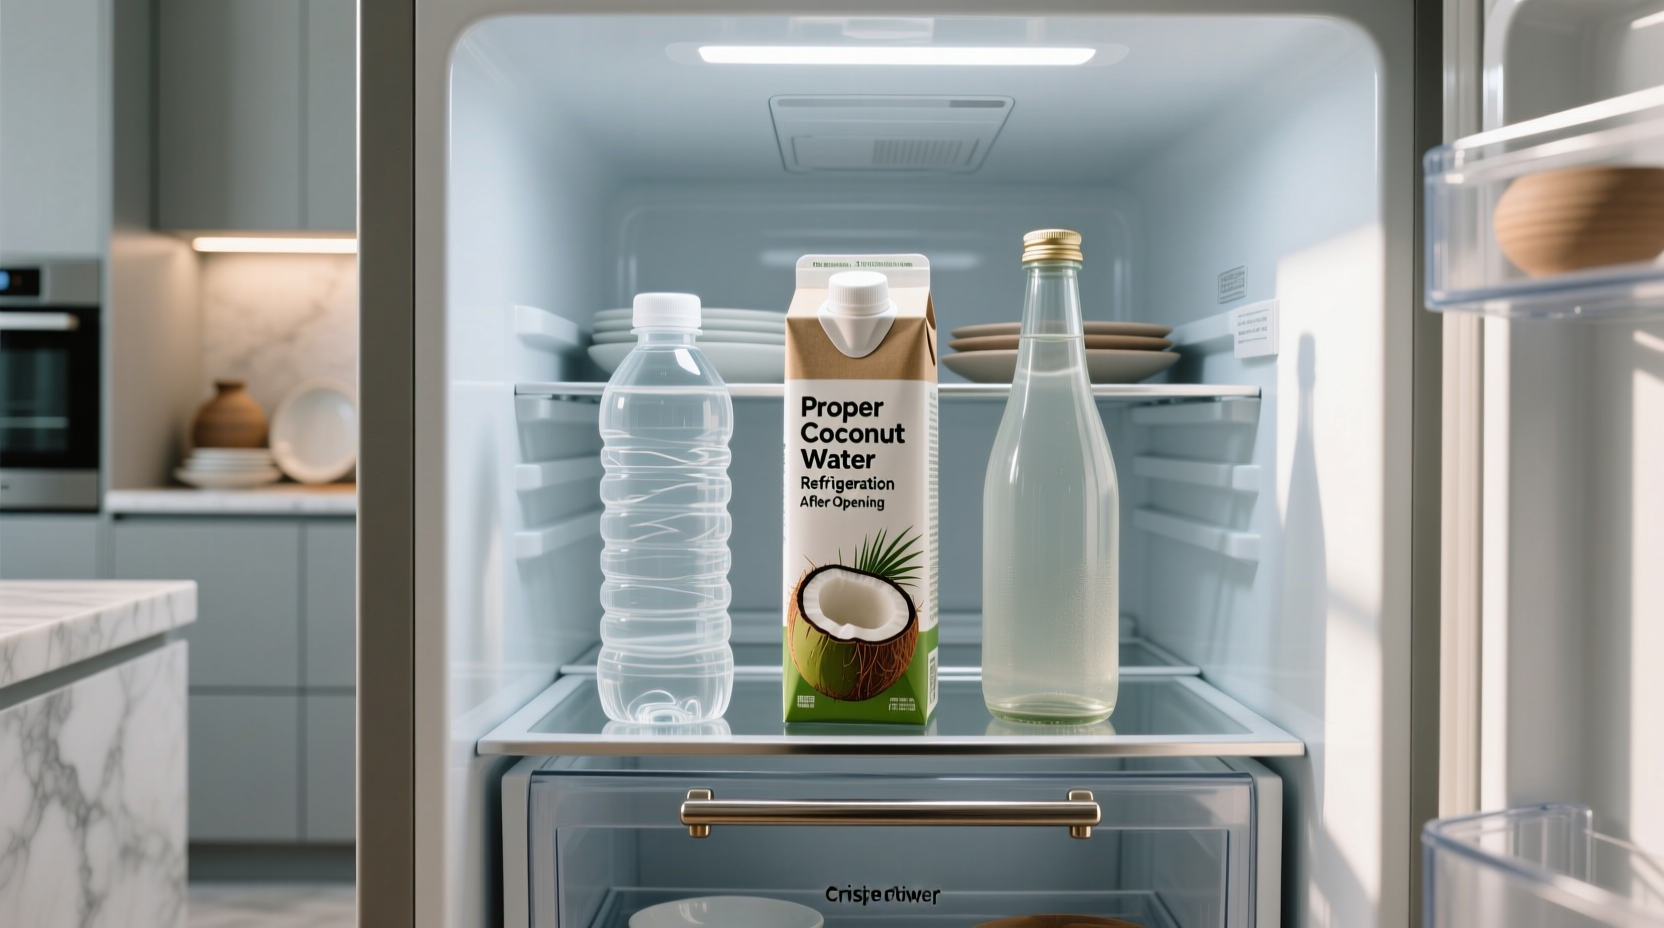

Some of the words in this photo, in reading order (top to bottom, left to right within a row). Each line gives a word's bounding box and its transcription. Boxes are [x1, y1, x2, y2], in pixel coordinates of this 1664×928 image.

[801, 396, 884, 423] Proper
[800, 421, 906, 444] Coconut
[800, 448, 876, 470] Water
[832, 496, 885, 511] Opening
